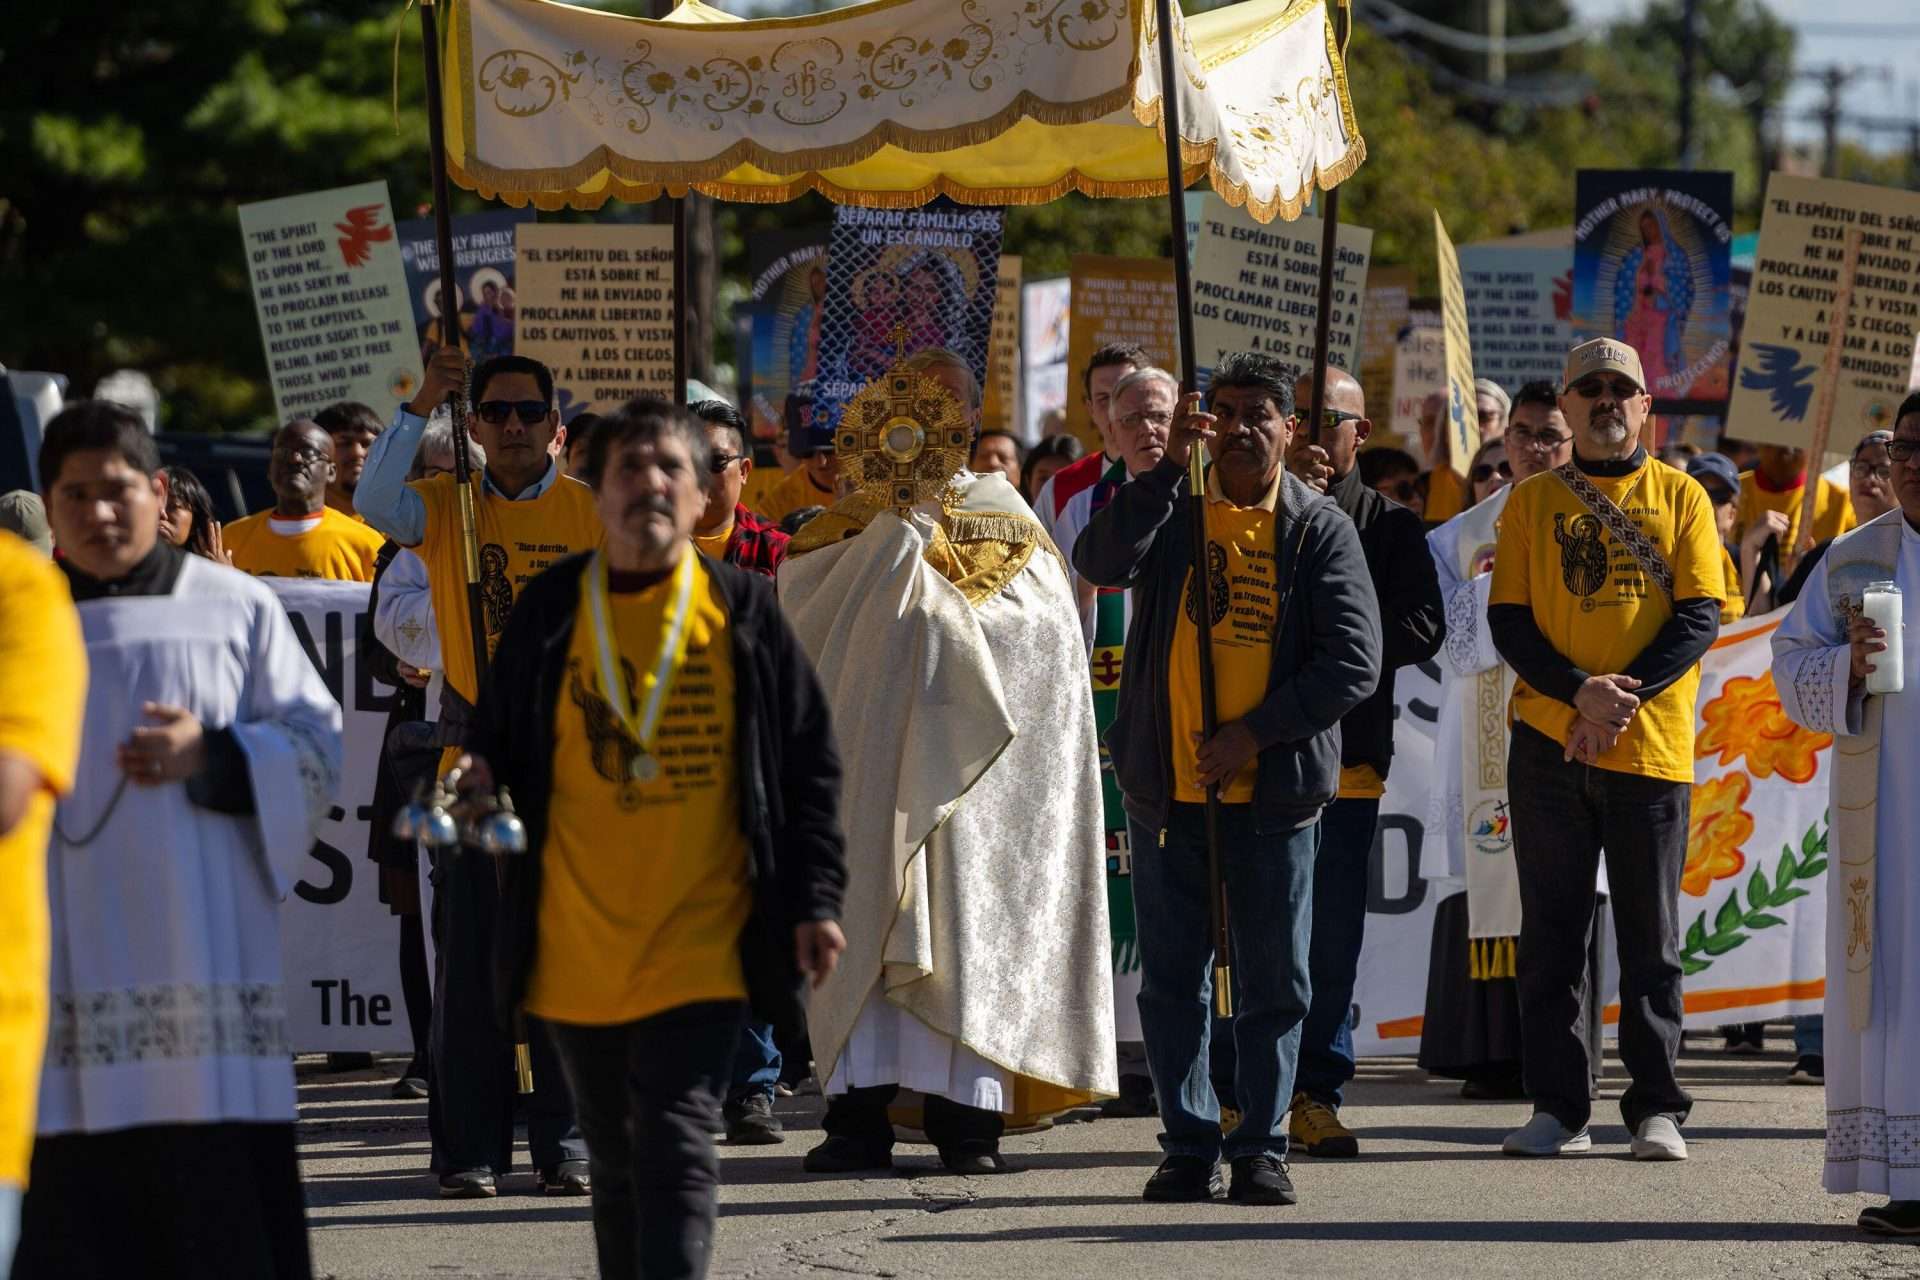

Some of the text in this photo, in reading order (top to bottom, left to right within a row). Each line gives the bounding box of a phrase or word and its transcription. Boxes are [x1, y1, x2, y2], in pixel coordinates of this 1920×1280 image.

[838, 207, 904, 226] SEPARAR
[910, 212, 976, 230] FAMILIAS
[1860, 211, 1882, 226] DEL
[282, 222, 317, 239] SPIRIT
[861, 229, 881, 244] UN
[1812, 224, 1844, 240] ESTÁ
[253, 239, 325, 263] OF THE LORD
[412, 239, 434, 257] THE
[471, 230, 513, 249] FAMILY
[547, 246, 603, 261] ESPÍRITU
[608, 249, 629, 262] DEL
[1231, 226, 1291, 251] ESPÍRITU
[1295, 240, 1317, 256] DEL
[1334, 246, 1365, 266] EÑOR
[1247, 249, 1279, 269] ESTÁ
[1284, 259, 1320, 276] SOBR
[1804, 244, 1822, 259] ME
[1827, 248, 1844, 261] HA
[1858, 253, 1910, 272] NVIADO
[256, 268, 269, 281] IS
[272, 262, 303, 278] UPON
[565, 266, 596, 281] ESTÁ
[601, 269, 641, 281] SOBRE
[751, 255, 790, 301] MOTHER
[1760, 259, 1838, 282] PROCLAMAR
[260, 271, 351, 300] HE HAS SENT ME
[561, 288, 578, 301] ME
[583, 288, 600, 301] HA
[604, 288, 662, 301] ENVIADO
[1239, 270, 1257, 285] ME
[1262, 274, 1279, 290] HA
[1350, 292, 1358, 306] A
[264, 285, 390, 318] TO PROCLAIM RELEASE
[1194, 280, 1273, 309] PROCLAMAR
[1278, 298, 1341, 323] LIBERD
[1346, 312, 1355, 326] A
[1759, 280, 1918, 317] LOS CAUTIVS, Y VISTA
[521, 308, 596, 321] PROCLAMAR
[601, 308, 661, 321] LIBERTAD
[1193, 302, 1219, 319] LOS
[1299, 324, 1308, 337] Y
[1816, 310, 1825, 323] A
[267, 322, 282, 336] TO
[287, 317, 307, 332] THE
[271, 320, 402, 353] RECOVER SIGHT TO THE
[522, 328, 547, 341] LOS
[624, 328, 632, 341] Y
[638, 328, 674, 341] VISTA
[315, 349, 338, 364] AND
[342, 345, 362, 360] SET
[366, 340, 392, 356] FREE
[1251, 335, 1260, 349] A
[1265, 340, 1290, 355] LOS
[1782, 326, 1791, 340] Y
[1795, 328, 1804, 341] A
[1871, 339, 1880, 353] A
[1885, 341, 1910, 358] LOS
[582, 348, 590, 361] A
[595, 348, 619, 361] LOS
[278, 361, 371, 391] THOSE WHO ARE
[552, 368, 674, 381] Y A LIBERAR A LOS
[311, 979, 392, 1026] The
